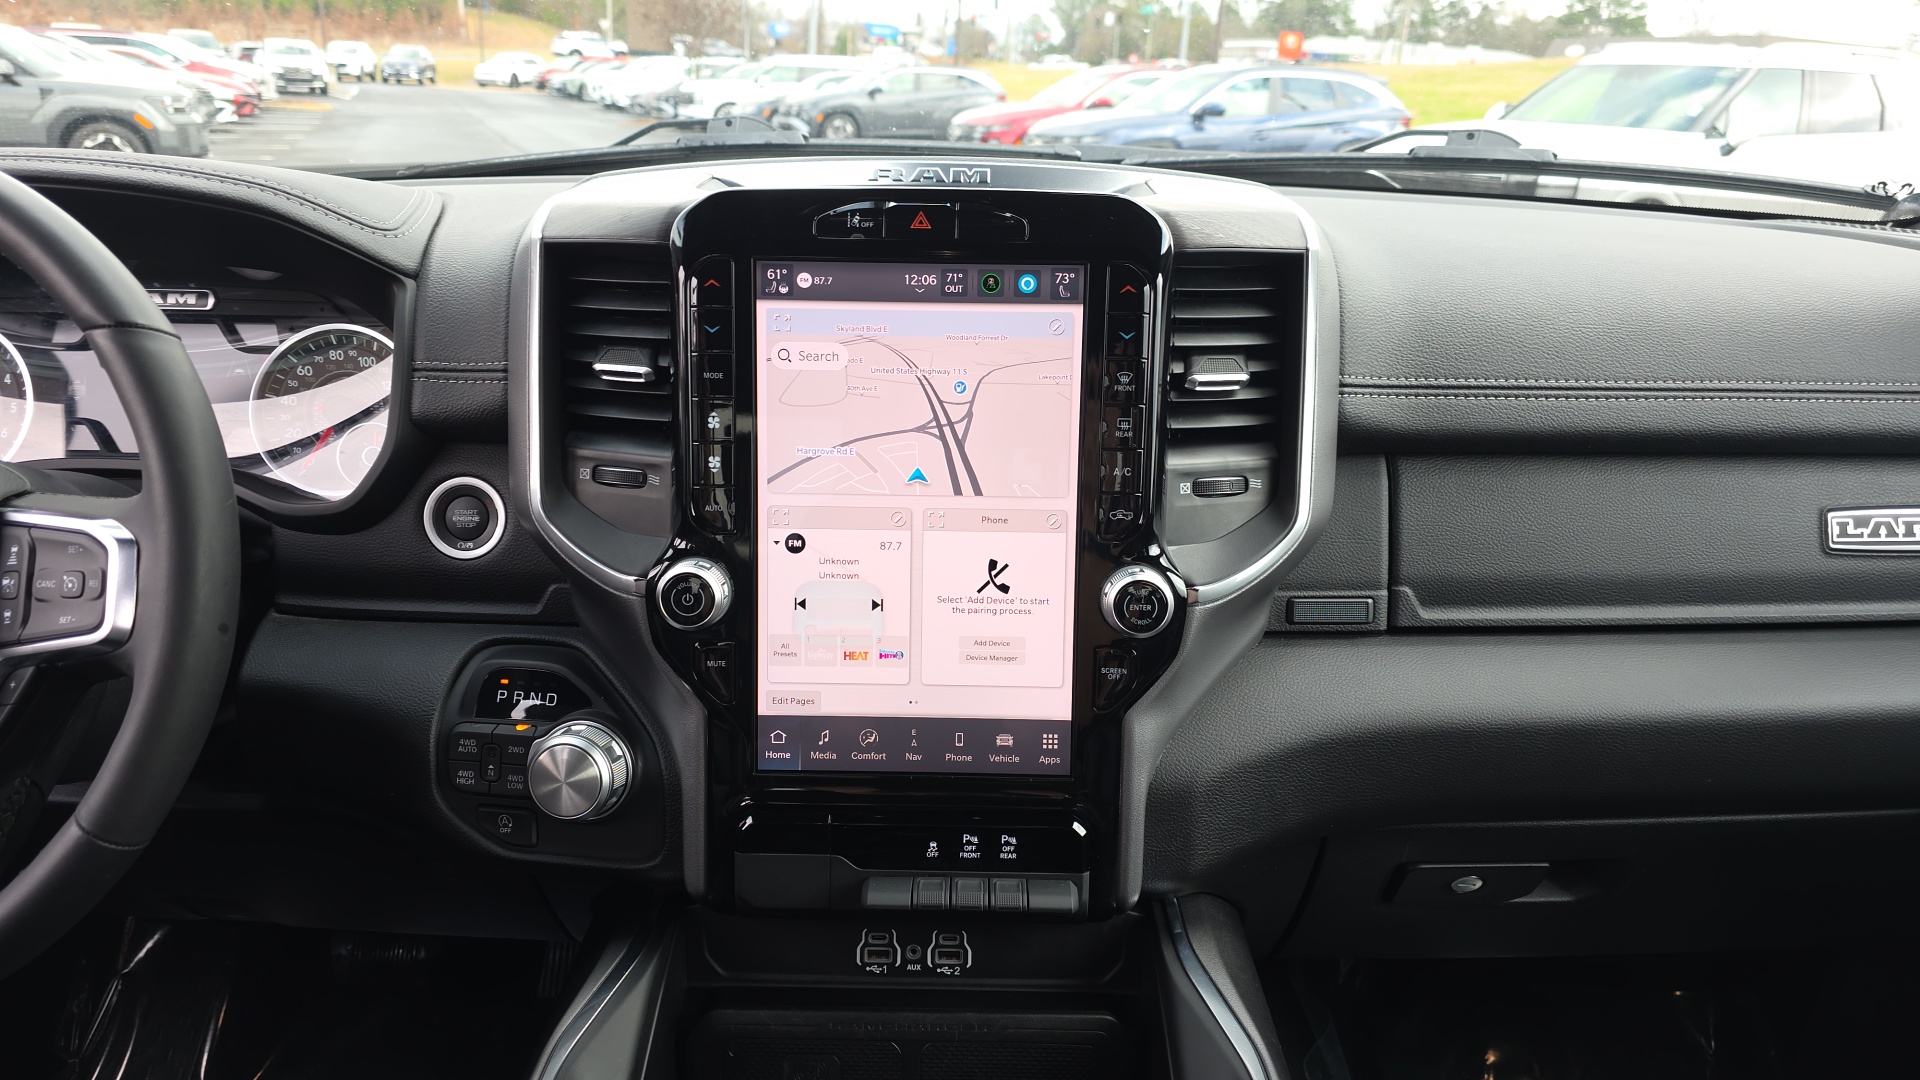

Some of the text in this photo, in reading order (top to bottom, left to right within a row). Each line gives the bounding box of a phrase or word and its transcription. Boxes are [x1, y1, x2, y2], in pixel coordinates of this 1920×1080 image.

[867, 167, 991, 184] RAM
[766, 268, 788, 280] 61°
[946, 273, 964, 283] 71°
[1054, 272, 1075, 284] 73°
[813, 276, 833, 285] 87.7
[904, 274, 938, 286] 12:06
[944, 285, 964, 293] OUT
[149, 293, 199, 305] AM
[836, 324, 865, 334] Skyland
[866, 324, 882, 333] Blvd
[945, 334, 976, 342] Woodland
[313, 355, 324, 363] 70
[328, 350, 344, 361] 80
[798, 350, 839, 362] Search
[357, 356, 376, 368] 100
[296, 366, 314, 377] 60
[703, 372, 724, 380] MODE
[870, 367, 892, 375] United
[895, 367, 918, 375] States
[920, 368, 951, 377] Highway
[4, 373, 12, 385] 4
[288, 380, 298, 388] 50
[380, 380, 392, 391] 12
[280, 396, 297, 406] 40
[10, 402, 17, 414] 5
[0, 427, 8, 438] 6
[284, 428, 302, 438] 20
[796, 446, 835, 456] Hargrove
[836, 447, 848, 455] Rd
[1113, 467, 1132, 476] A/C
[704, 504, 724, 512] AUTO
[980, 516, 1009, 524] Phone
[788, 539, 802, 548] FM
[880, 542, 902, 551] 87.7
[818, 557, 860, 566] Unknown
[818, 572, 860, 580] Unknown
[36, 580, 56, 588] CANC
[936, 596, 963, 605] Select
[1019, 598, 1028, 606] to
[1028, 598, 1050, 606] start
[952, 606, 1034, 617] the pairing process.
[773, 650, 798, 658] Presets
[843, 651, 870, 660] HEAT
[988, 655, 1018, 663] Manager
[496, 690, 558, 706] P R N D
[772, 696, 816, 707] Edit Pages
[458, 738, 476, 746] 4WD
[458, 746, 478, 754] AUTO
[508, 746, 525, 754] 2WD
[765, 750, 791, 760] Home
[810, 750, 837, 760] Media
[851, 751, 887, 761] Comfort
[905, 752, 922, 761] Nav
[945, 753, 973, 762] Phone
[988, 754, 1020, 764] Vehicle
[1038, 755, 1061, 766] Apps
[457, 770, 475, 778] 4WD
[456, 777, 475, 786] HIGH
[507, 782, 524, 790] LOW
[882, 966, 888, 974] 1
[954, 966, 961, 975] 2
